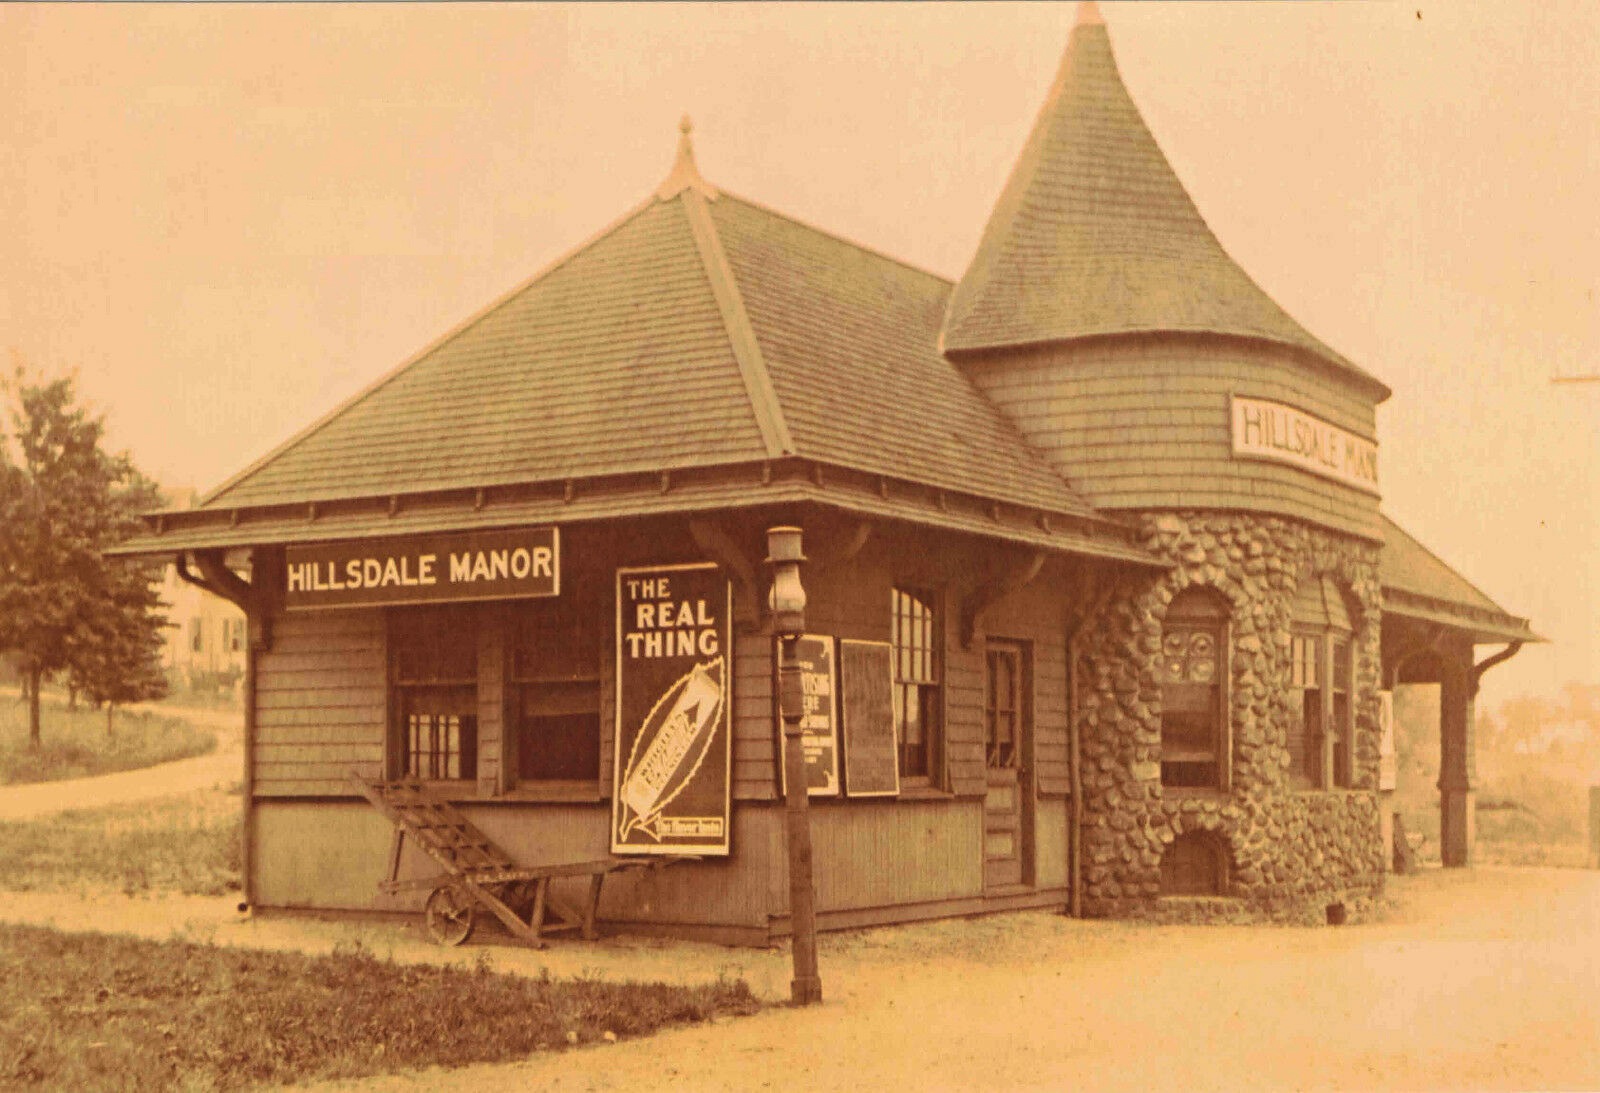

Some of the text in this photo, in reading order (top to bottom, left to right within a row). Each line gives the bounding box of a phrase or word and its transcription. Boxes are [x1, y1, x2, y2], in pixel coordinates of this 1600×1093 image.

[287, 546, 552, 592] HILLSDALE MANOR
[626, 577, 671, 600] THE
[636, 600, 715, 629] REAL
[625, 628, 719, 659] THING
